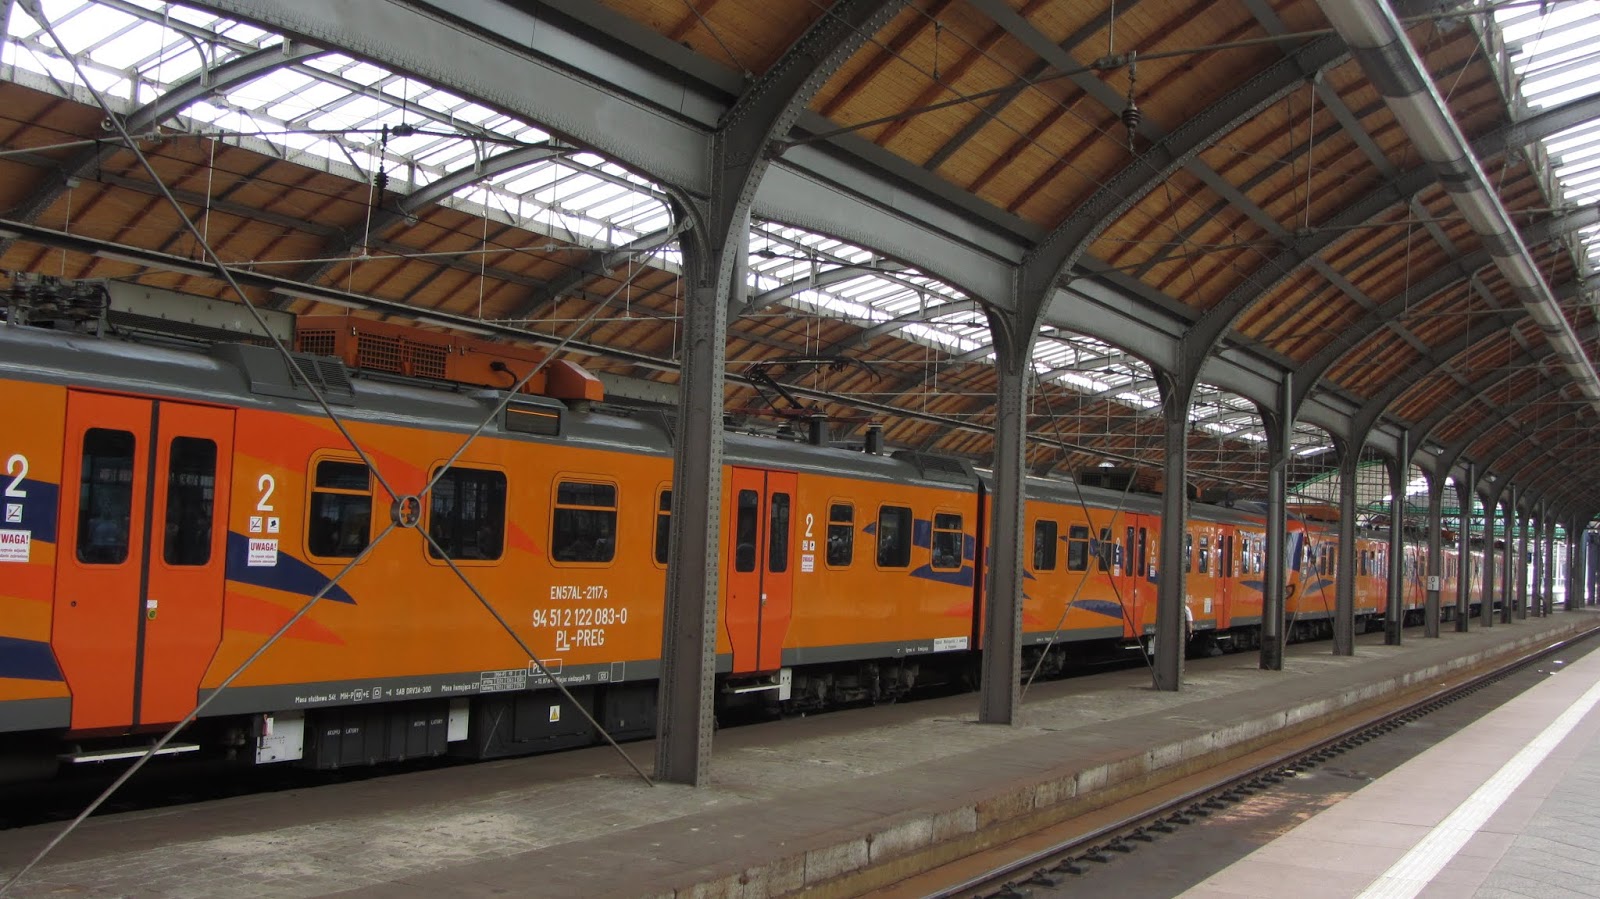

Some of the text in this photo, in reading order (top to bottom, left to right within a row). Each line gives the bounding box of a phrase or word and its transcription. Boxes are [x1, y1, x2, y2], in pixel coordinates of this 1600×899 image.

[5, 454, 29, 497] 2
[257, 474, 274, 511] 2
[805, 513, 813, 537] 2
[250, 542, 276, 551] UWAGA!
[1116, 537, 1120, 553] 2
[1151, 540, 1155, 555] 2
[533, 608, 627, 627] 94 51 2 122 083-0
[556, 629, 604, 651] PL-PREG
